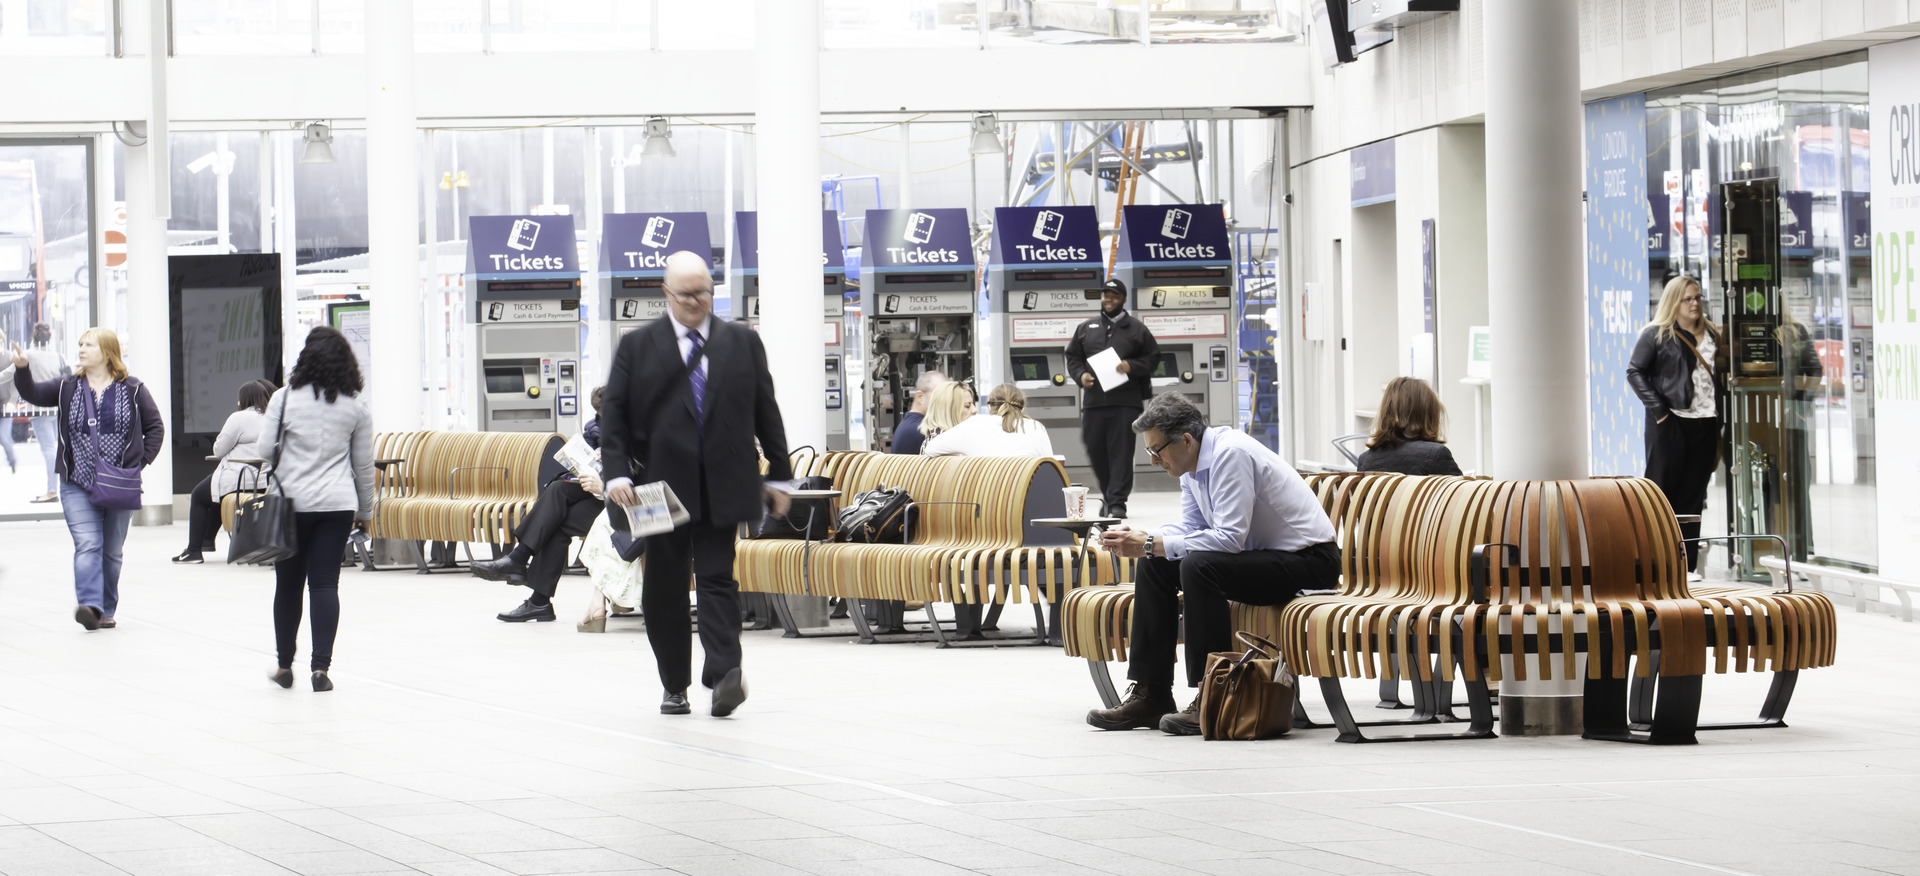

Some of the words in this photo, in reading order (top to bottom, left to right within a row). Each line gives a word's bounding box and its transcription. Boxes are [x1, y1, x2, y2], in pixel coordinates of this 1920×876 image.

[1602, 130, 1628, 160] LONDON
[1604, 168, 1627, 198] BRIDGE
[1047, 213, 1054, 221] S
[523, 222, 530, 230] S
[886, 247, 959, 263] Tickets
[1015, 244, 1087, 260] Tickets
[1145, 242, 1216, 258] Tickets
[489, 253, 564, 270] Tickets
[624, 251, 668, 268] Tick
[1875, 231, 1917, 323] OPE
[908, 295, 938, 303] TICKETS
[1050, 292, 1079, 300] TICKETS
[1602, 290, 1632, 334] FEAST
[1877, 343, 1918, 400] SPRIN
